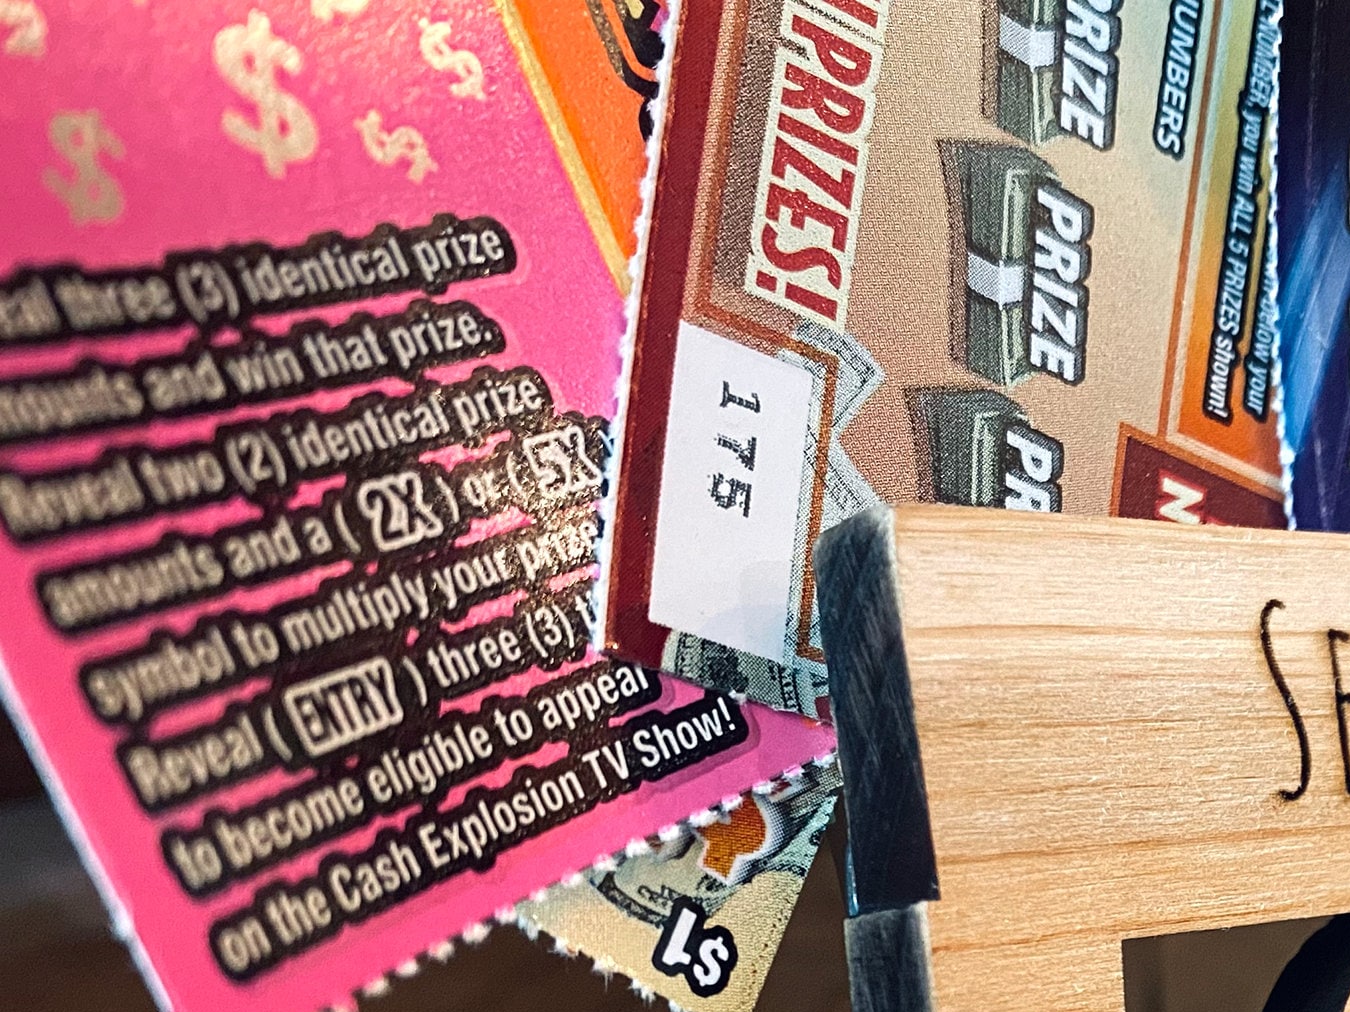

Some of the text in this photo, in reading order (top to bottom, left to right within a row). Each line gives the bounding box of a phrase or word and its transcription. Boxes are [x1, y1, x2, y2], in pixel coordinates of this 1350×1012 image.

[1060, 0, 1112, 149] RIZE
[756, 14, 874, 322] PRIZES!
[1237, 154, 1259, 193] win
[1241, 108, 1263, 153] you
[1228, 239, 1250, 257] 5
[1230, 195, 1256, 234] ALL
[175, 260, 240, 324] (3)
[235, 236, 409, 304] identical
[411, 227, 505, 282] prize
[1030, 189, 1086, 381] PRIZE
[1218, 256, 1248, 336] PRIZES
[223, 339, 305, 395] win
[304, 315, 388, 378] that
[388, 312, 494, 372] prize.
[1208, 335, 1236, 418] shown!
[1246, 358, 1270, 415] your
[224, 428, 289, 494] (2)
[281, 391, 450, 471] identical
[454, 376, 542, 437] prize
[225, 514, 303, 579] and
[302, 517, 333, 555] a
[462, 471, 503, 508] or
[230, 620, 280, 669] to
[280, 572, 430, 653] multiply
[432, 544, 508, 610] your
[126, 711, 265, 805] Reveal
[427, 623, 522, 689] three
[524, 603, 576, 659] (3)
[170, 835, 223, 890] to
[214, 777, 364, 870] become
[366, 726, 494, 803] eligible
[493, 706, 534, 743] to
[216, 697, 737, 974] on the Cash Explosion TV Show!
